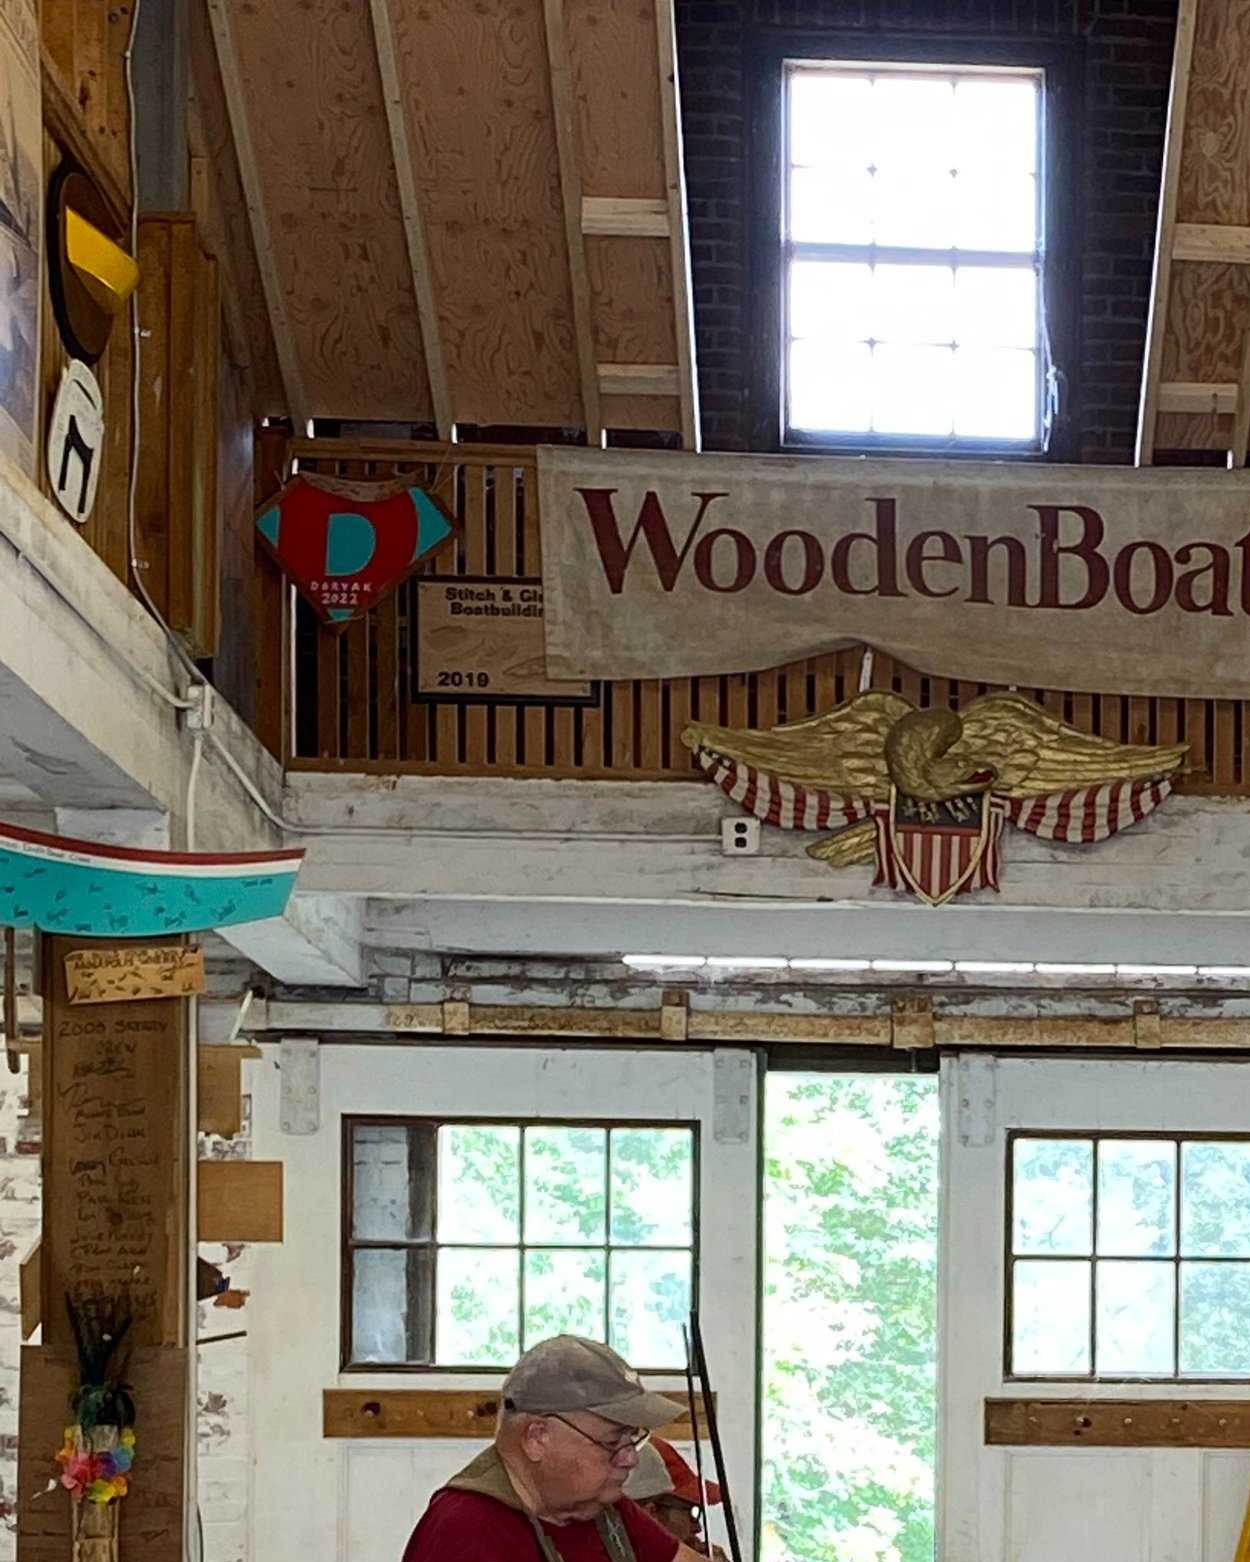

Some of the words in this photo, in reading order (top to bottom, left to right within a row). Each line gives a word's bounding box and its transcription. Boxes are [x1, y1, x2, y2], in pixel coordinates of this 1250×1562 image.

[325, 512, 376, 577] D
[321, 592, 359, 605] 2022
[444, 586, 496, 601] Stitch
[502, 588, 513, 602] &
[437, 671, 489, 688] 2019
